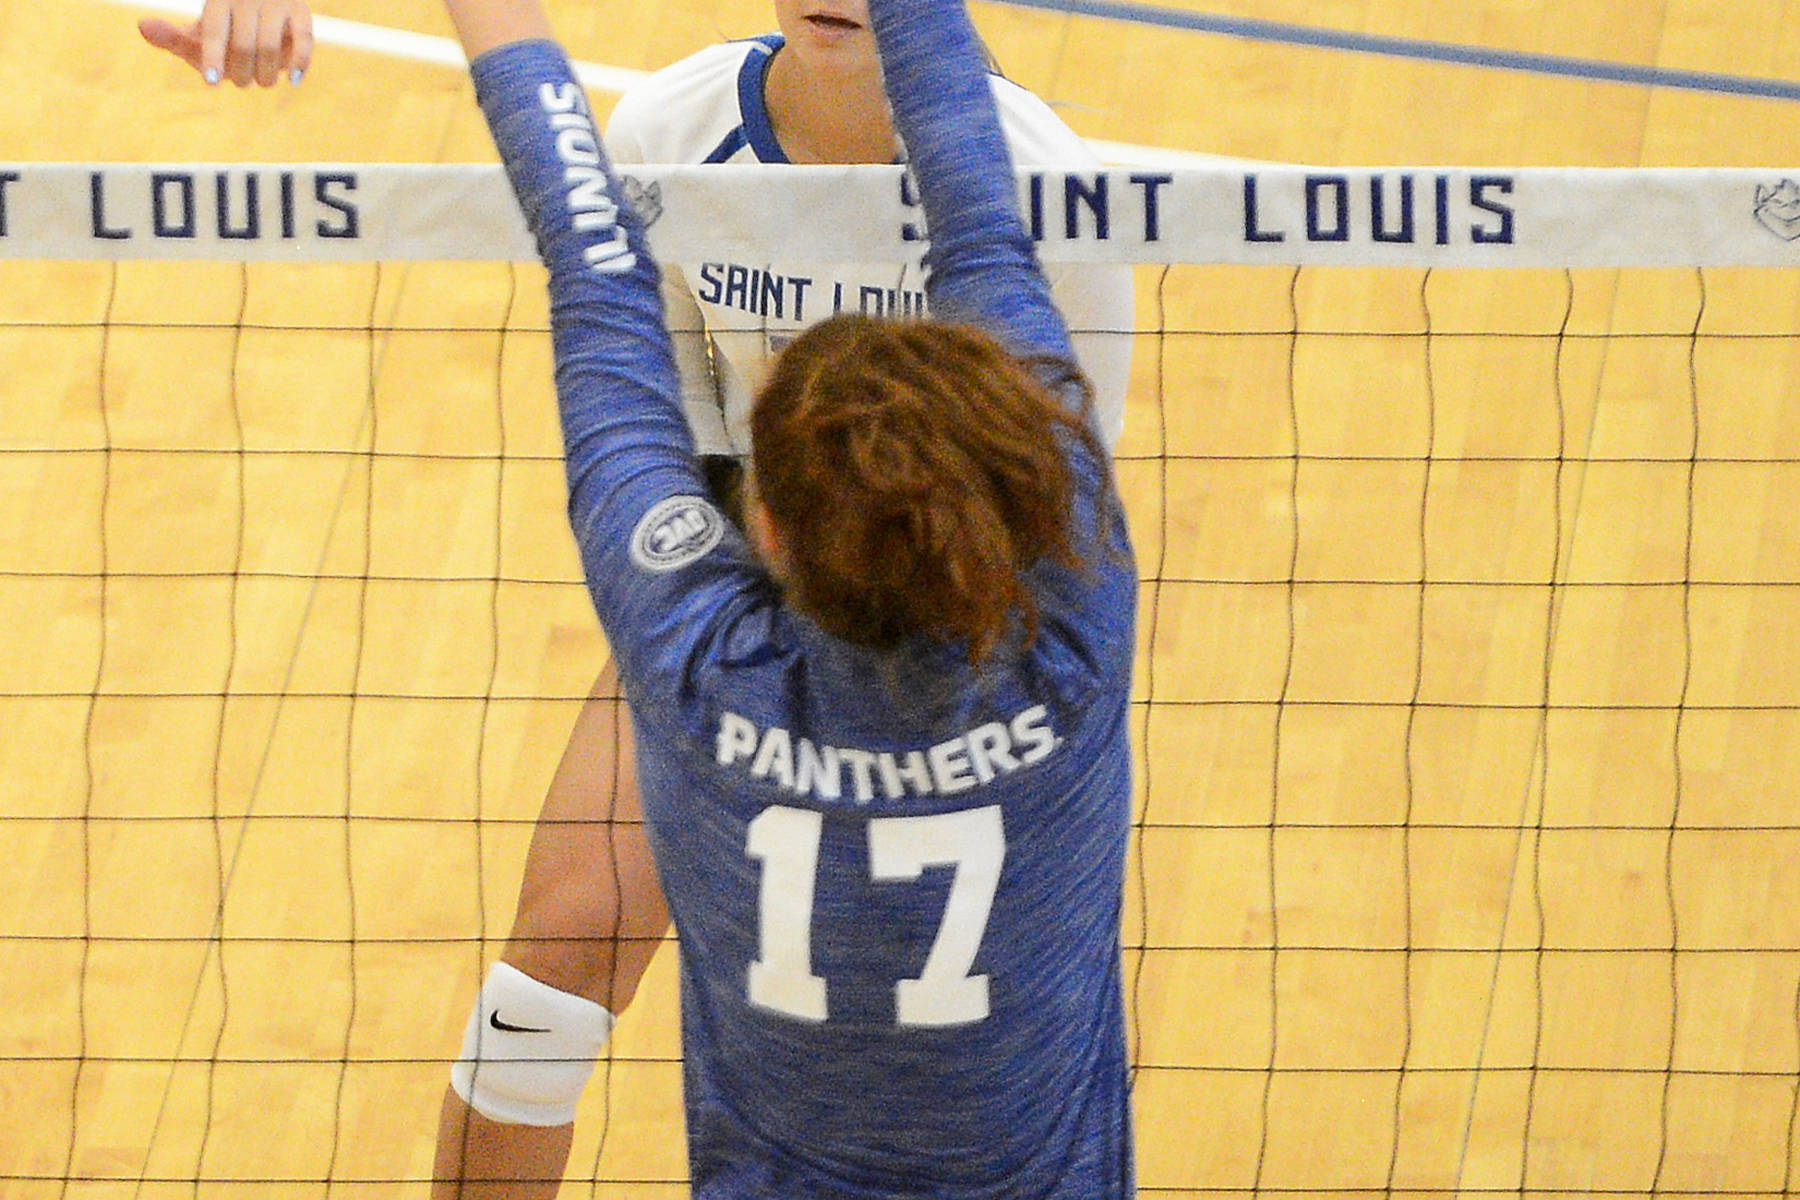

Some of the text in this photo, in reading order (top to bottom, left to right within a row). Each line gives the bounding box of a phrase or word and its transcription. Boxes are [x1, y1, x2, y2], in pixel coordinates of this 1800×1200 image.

[89, 171, 361, 239] LOUIS
[539, 82, 637, 274] ILLNOIS
[901, 172, 1514, 245] INT LOUIS
[698, 262, 813, 322] SAINT
[716, 704, 1062, 804] PANTHERS
[745, 803, 1006, 1026] 17
